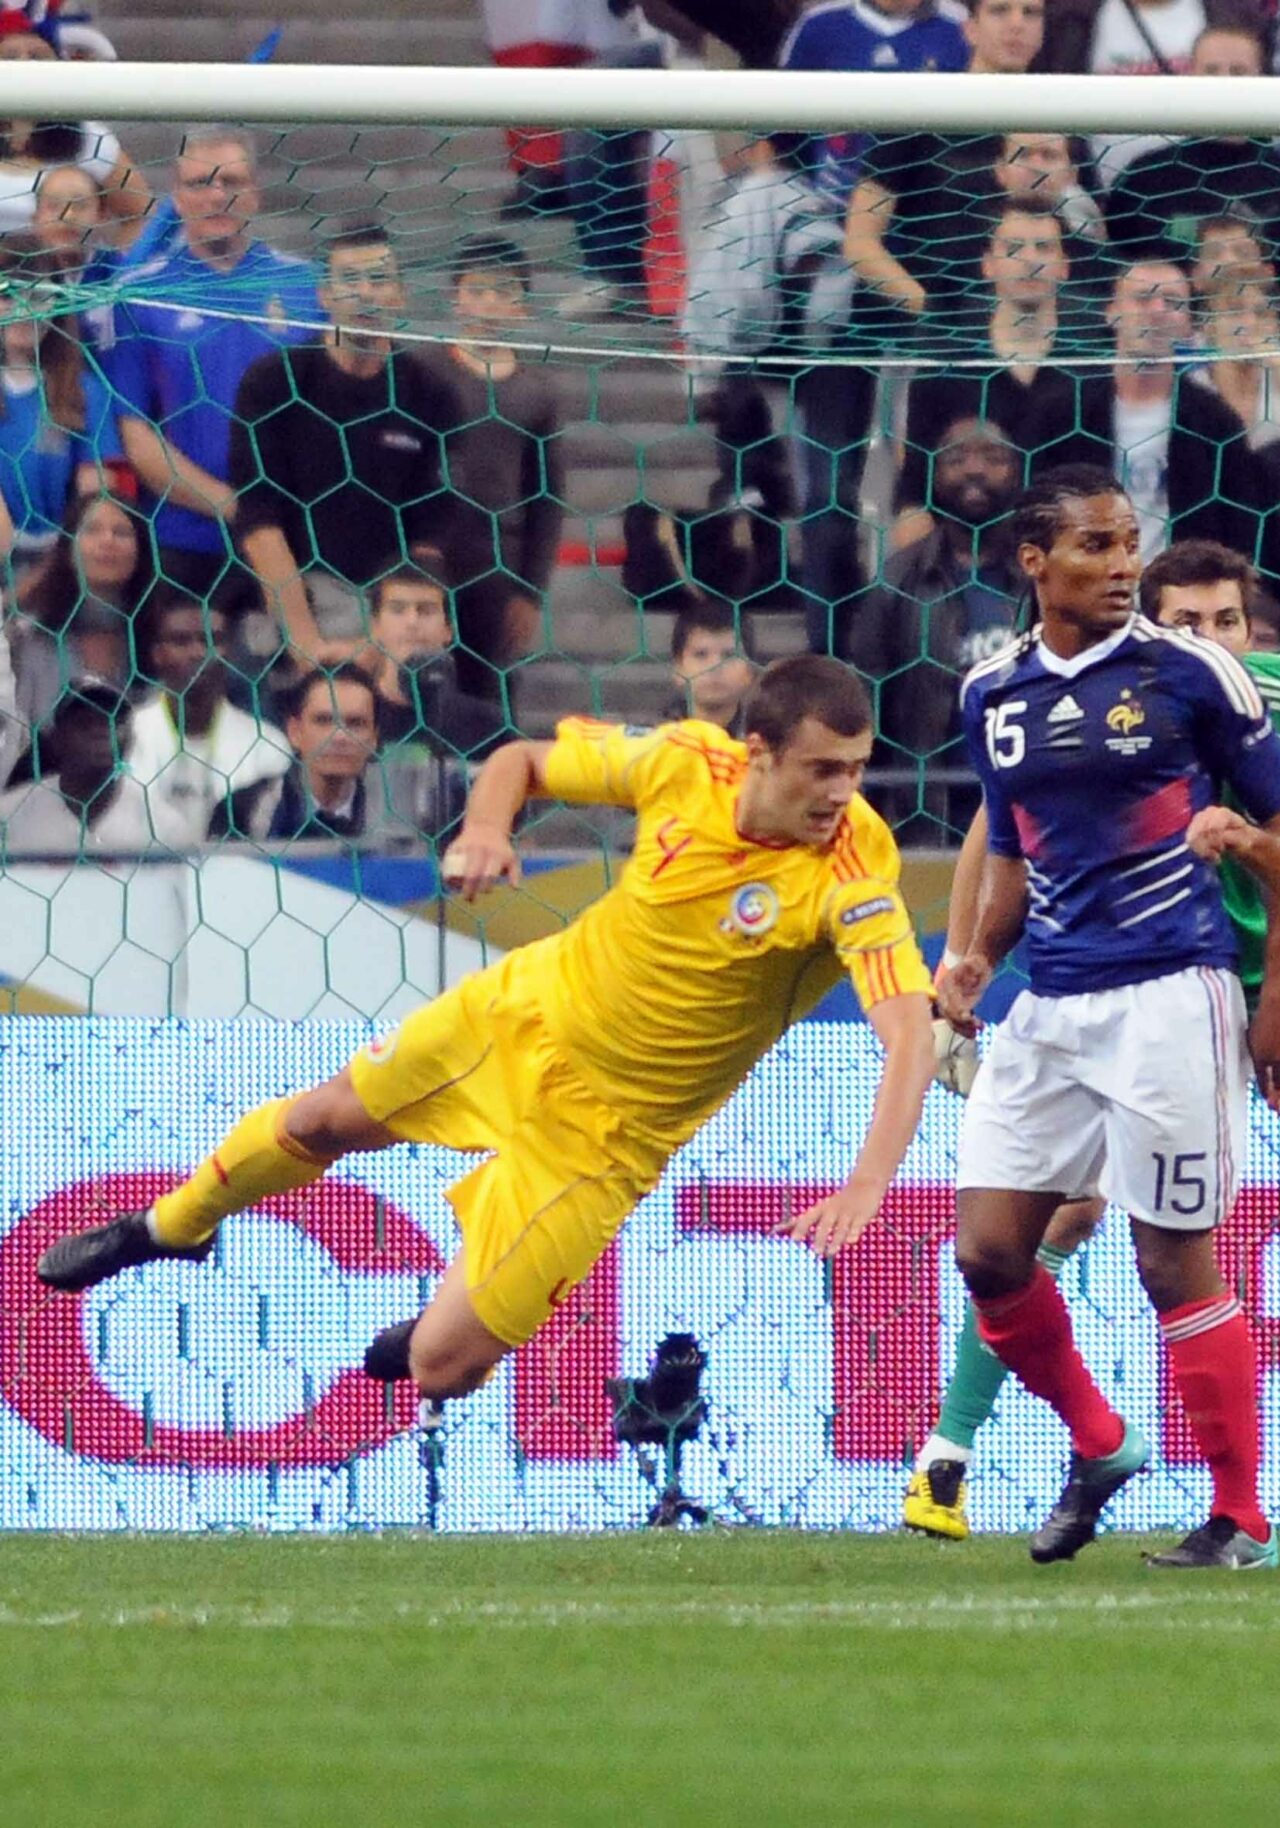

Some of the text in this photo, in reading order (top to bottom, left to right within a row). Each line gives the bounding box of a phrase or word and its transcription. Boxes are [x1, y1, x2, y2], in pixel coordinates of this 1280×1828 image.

[983, 700, 1028, 771] 15
[650, 815, 693, 879] 4
[1151, 1151, 1207, 1215] 15
